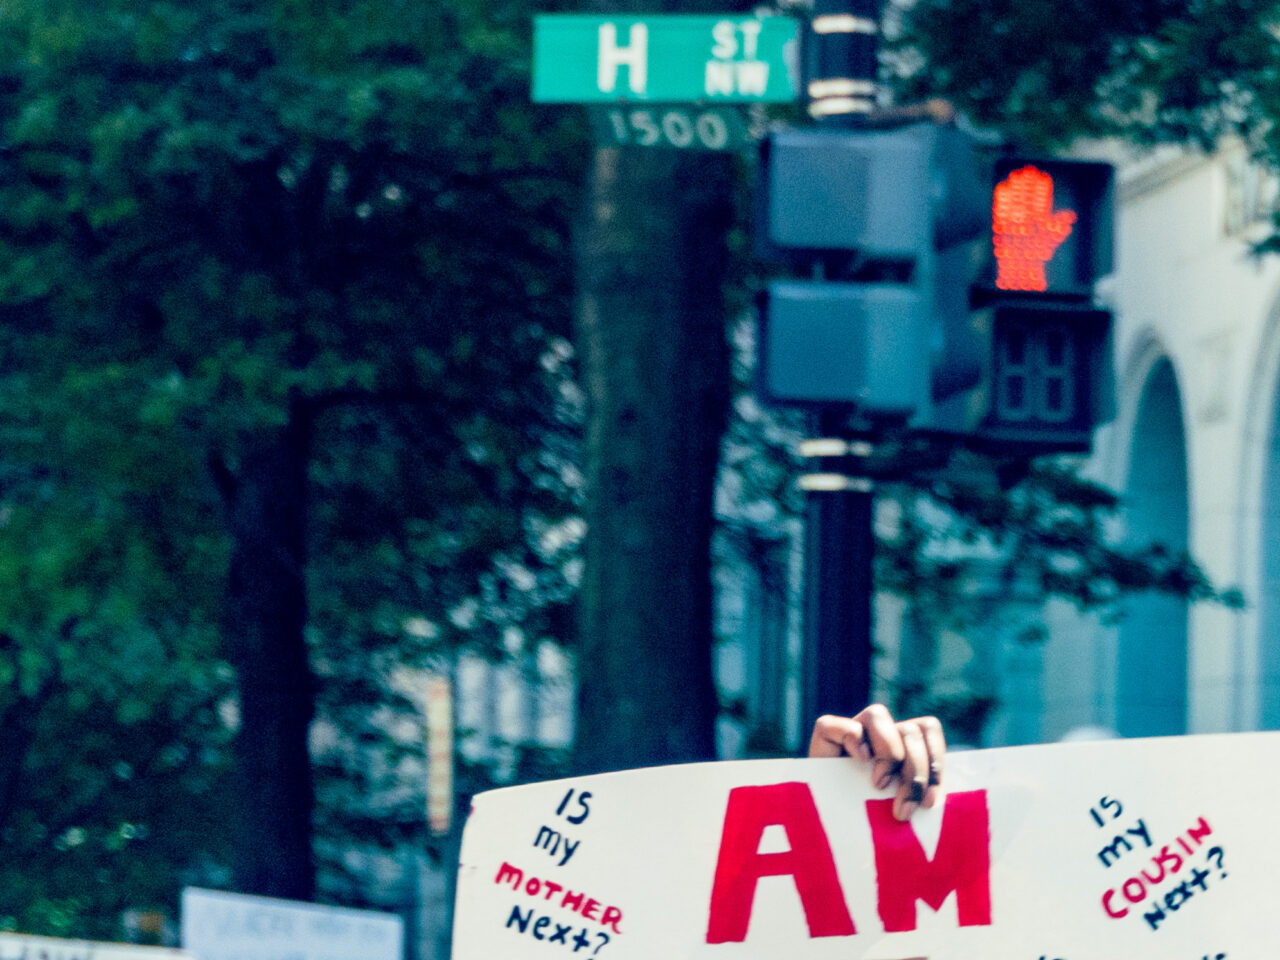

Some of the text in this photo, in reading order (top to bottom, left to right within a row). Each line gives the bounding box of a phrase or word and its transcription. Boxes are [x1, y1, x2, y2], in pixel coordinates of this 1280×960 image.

[597, 21, 648, 95] H
[712, 20, 762, 59] ST
[704, 60, 770, 96] NW
[609, 110, 728, 150] 1500
[555, 788, 593, 825] IS
[1089, 795, 1124, 828] IS
[706, 781, 992, 944] AM
[1101, 815, 1213, 920] COUSIN
[494, 861, 623, 935] MOTHER
